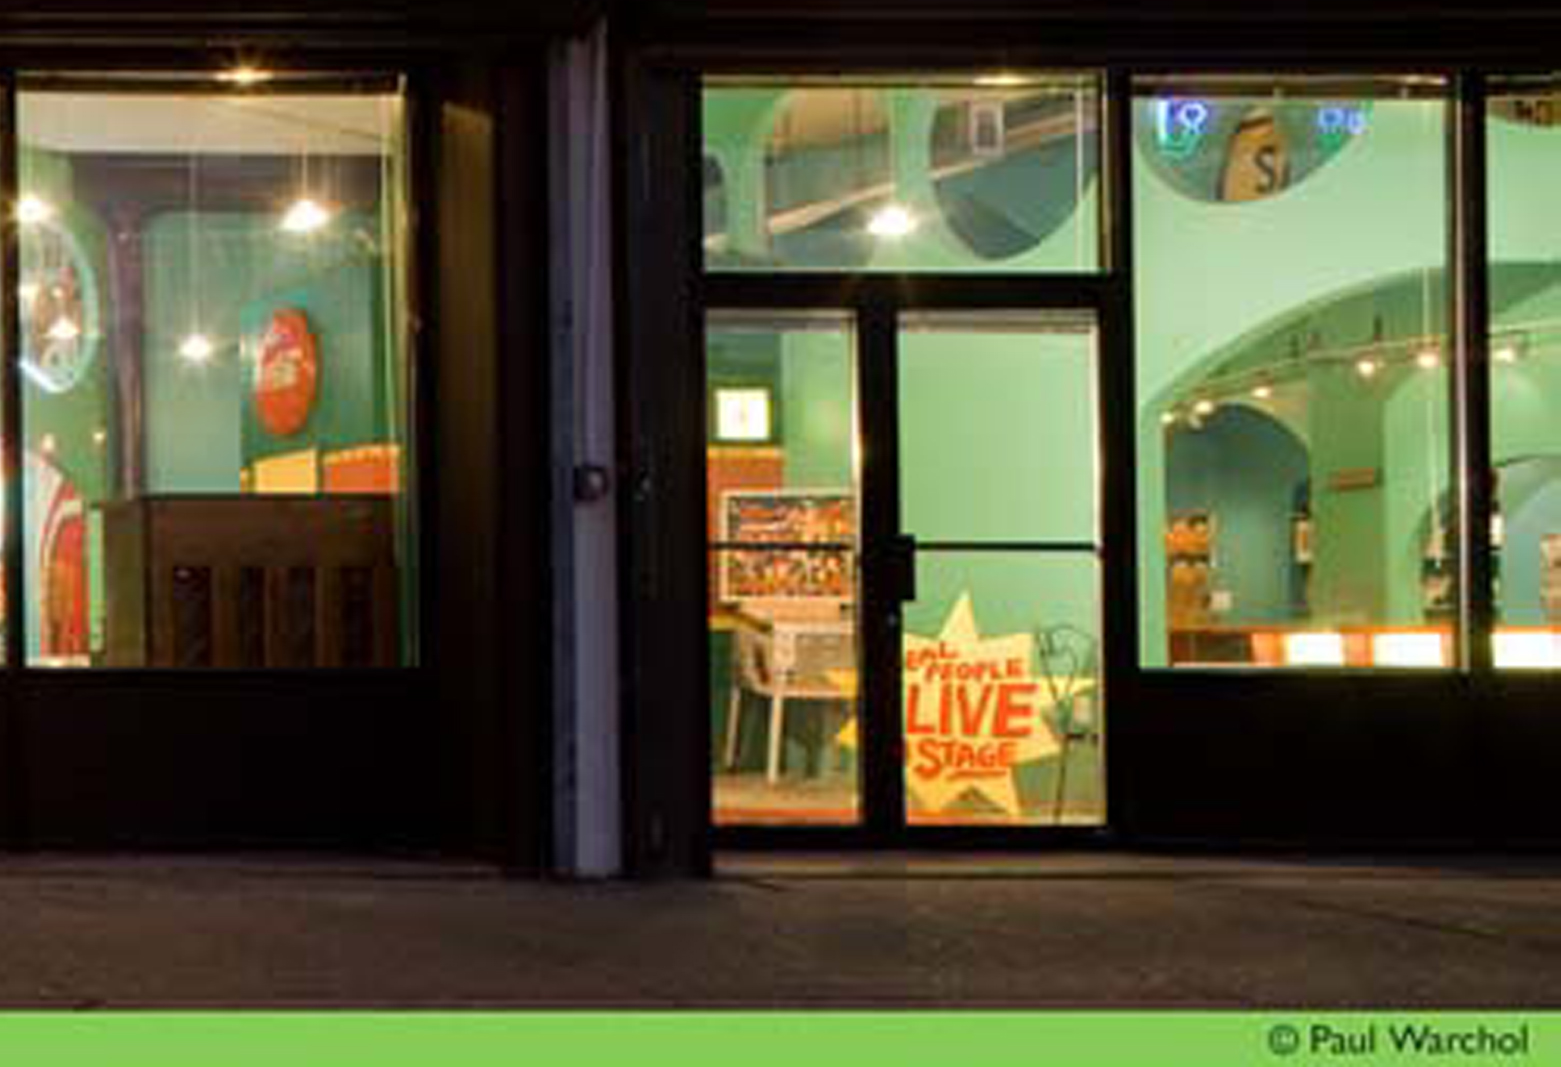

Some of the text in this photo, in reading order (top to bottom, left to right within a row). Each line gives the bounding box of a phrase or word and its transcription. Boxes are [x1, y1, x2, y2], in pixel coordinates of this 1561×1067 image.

[905, 641, 959, 671] EAL
[924, 658, 1024, 683] PEOPLE
[906, 682, 1040, 738] LIVE
[913, 737, 1019, 780] STAGE
